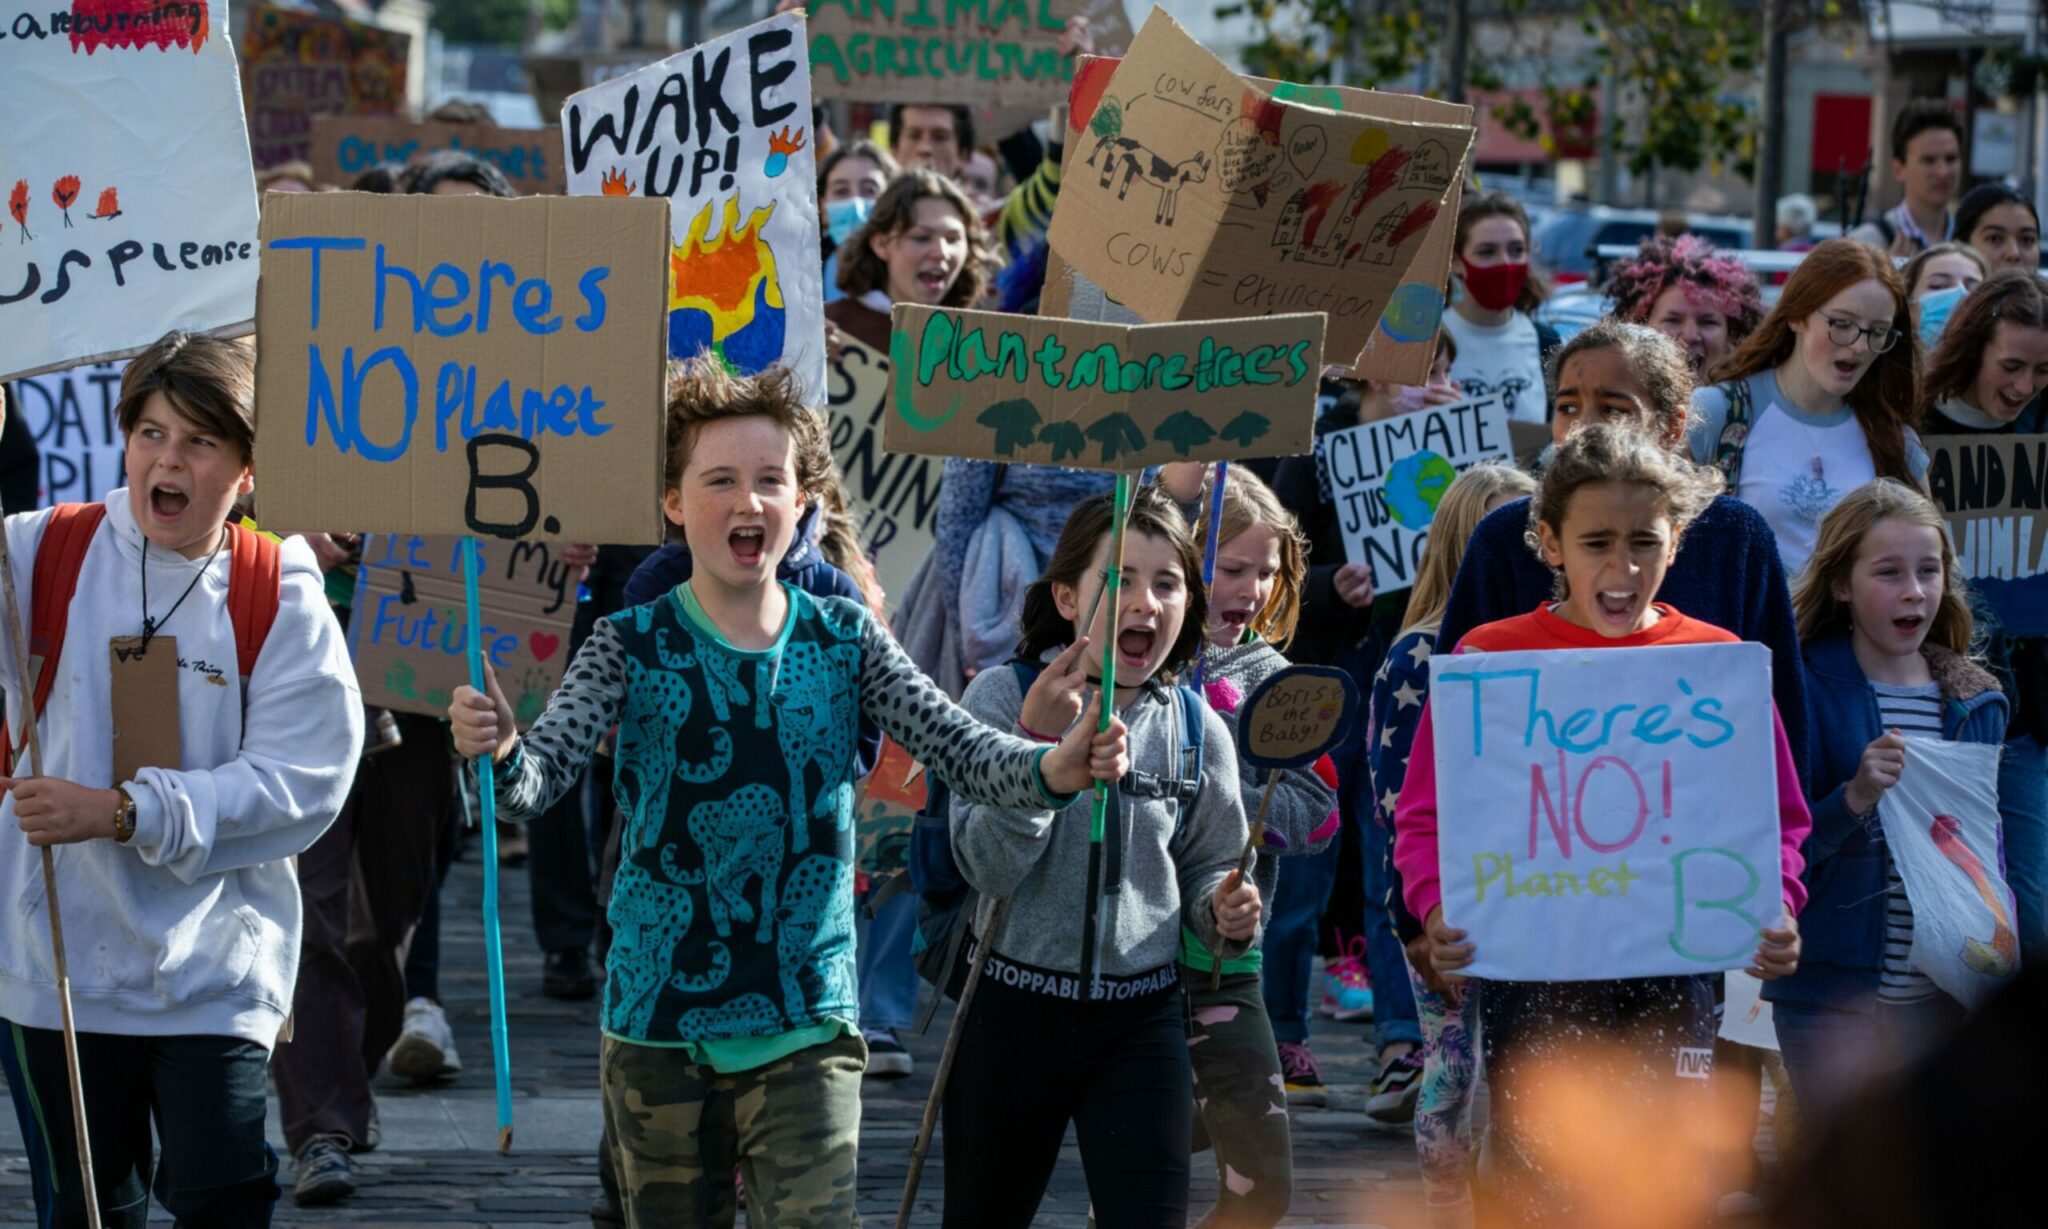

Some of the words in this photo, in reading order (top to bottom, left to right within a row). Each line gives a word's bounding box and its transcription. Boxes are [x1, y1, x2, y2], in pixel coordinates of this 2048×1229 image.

[73, 0, 200, 36] burning
[570, 29, 797, 174] WAKE
[338, 135, 420, 173] Our
[644, 136, 739, 197] UP!
[269, 236, 611, 337] Theres
[1233, 274, 1373, 318] extinction
[918, 310, 1066, 389] Plant
[305, 344, 419, 463] NO
[1331, 400, 1498, 488] CLIMATE
[464, 433, 561, 540] B.
[2010, 441, 2048, 511] N
[1437, 669, 1735, 757] There's
[1528, 747, 1673, 861] NO!
[1472, 851, 1640, 904] Planet
[1668, 847, 1761, 962] B
